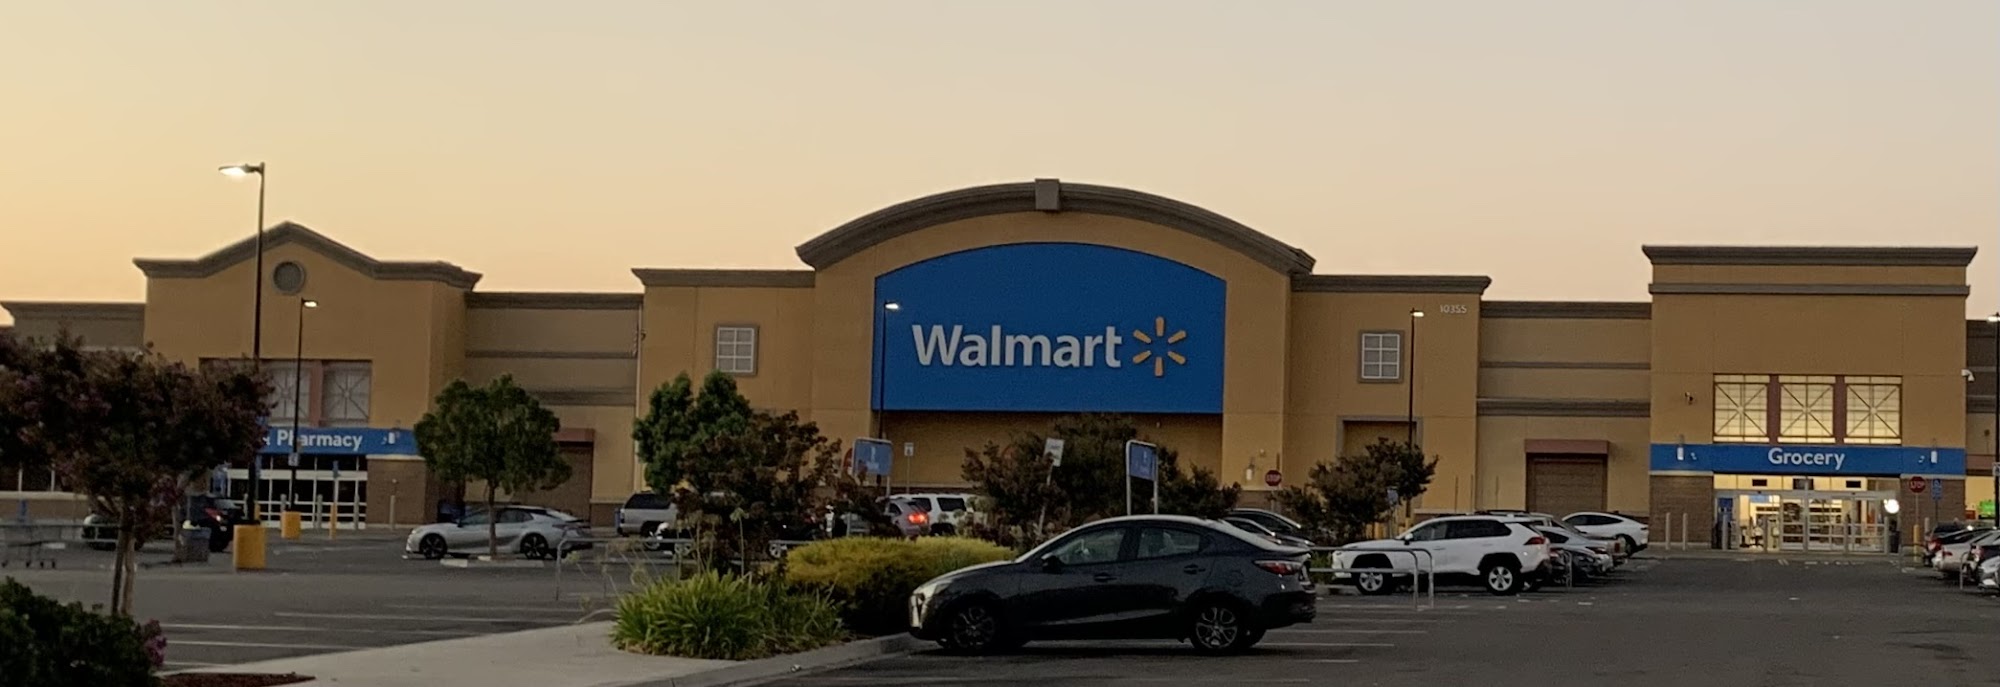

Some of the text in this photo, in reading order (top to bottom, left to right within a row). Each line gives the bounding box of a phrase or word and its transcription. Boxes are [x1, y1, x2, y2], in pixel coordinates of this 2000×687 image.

[1440, 304, 1467, 313] 10355
[912, 325, 1122, 367] Walmart
[1767, 447, 1845, 470] Grocery
